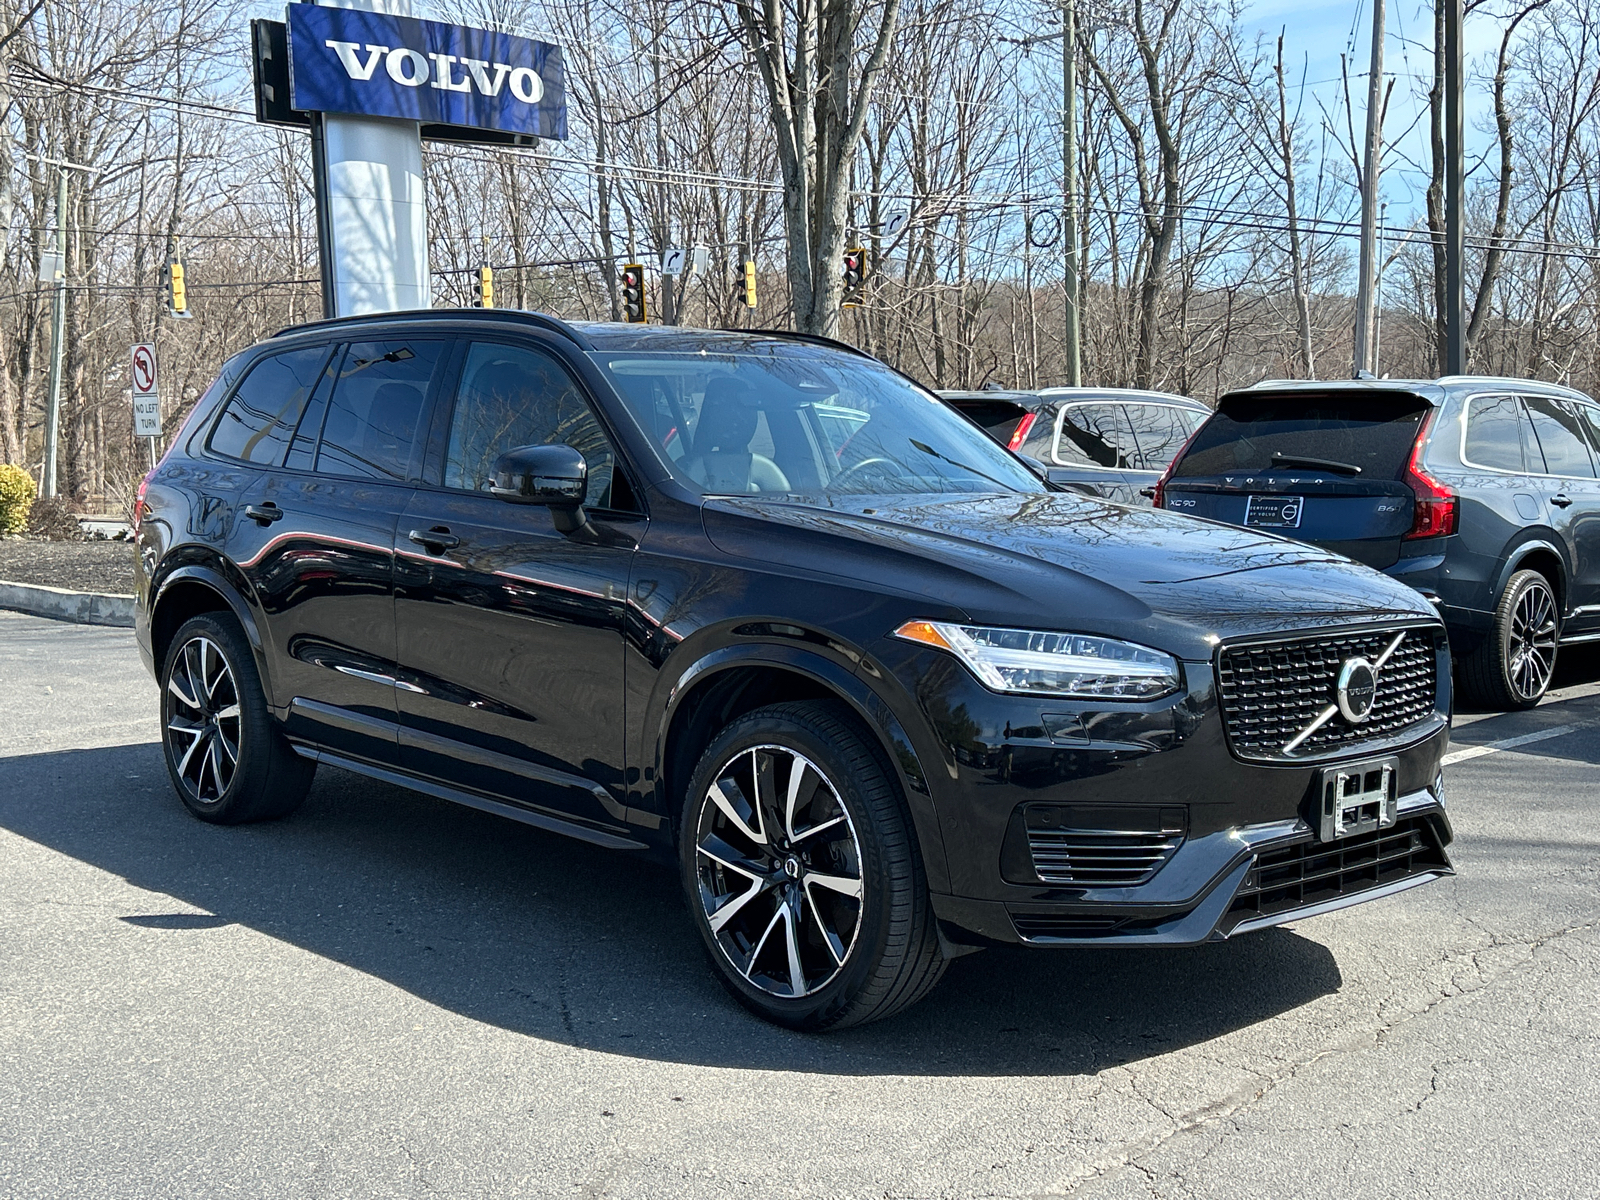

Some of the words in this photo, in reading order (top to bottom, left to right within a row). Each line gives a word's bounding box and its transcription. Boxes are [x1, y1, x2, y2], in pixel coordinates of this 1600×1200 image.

[325, 39, 545, 104] VOLVO
[136, 404, 144, 414] NO
[146, 404, 158, 414] LEFT
[141, 418, 156, 428] TURN
[1225, 477, 1323, 485] VOLVO
